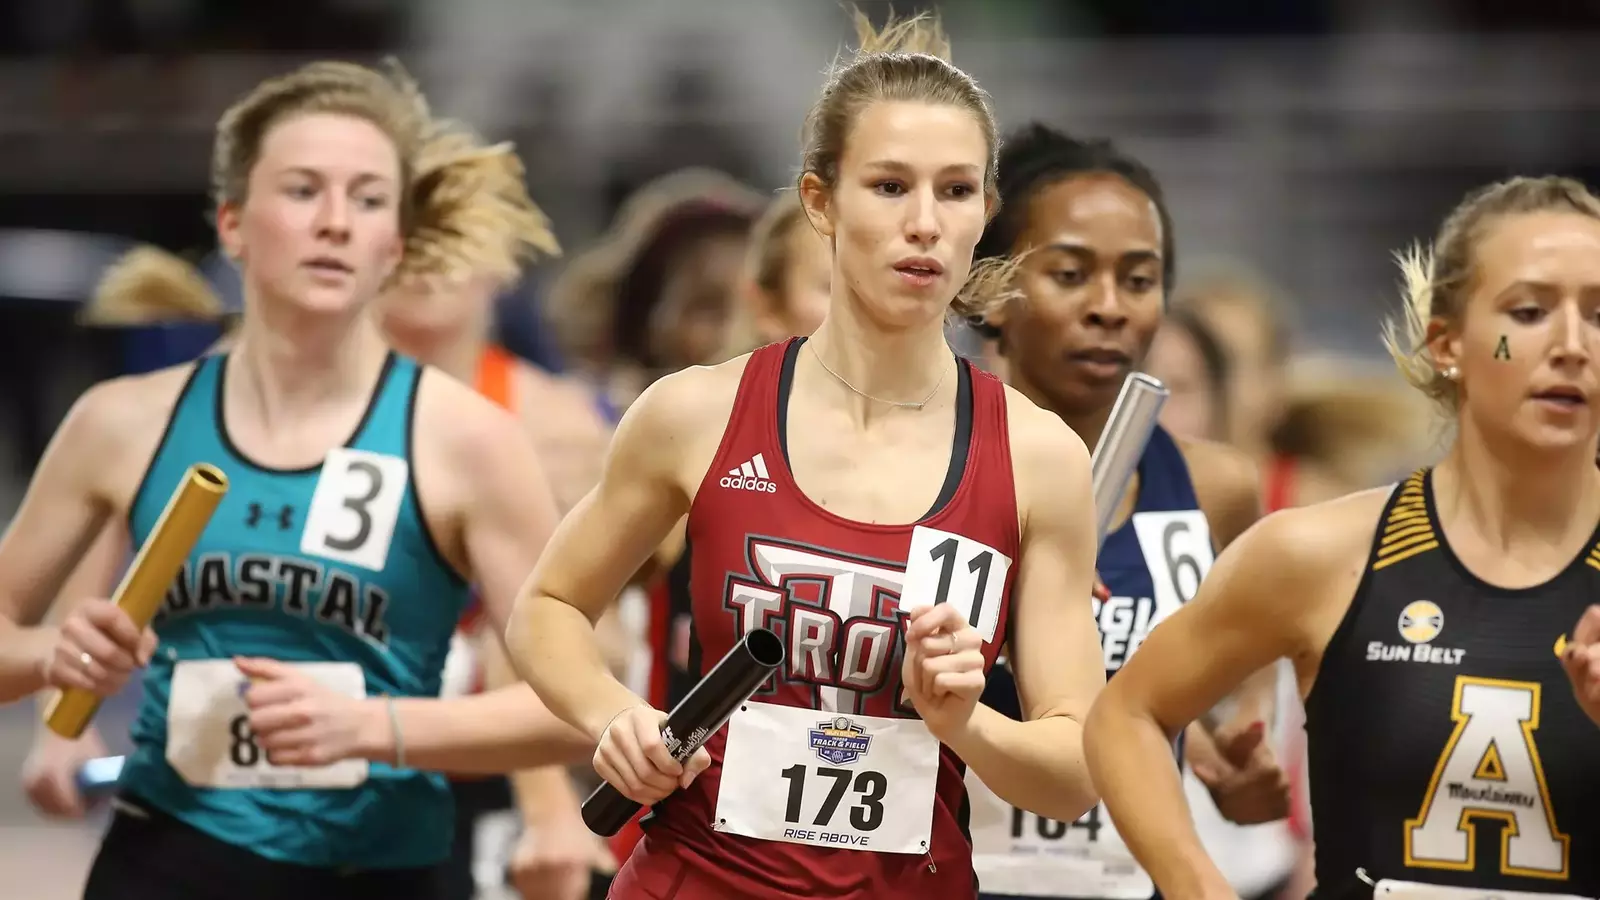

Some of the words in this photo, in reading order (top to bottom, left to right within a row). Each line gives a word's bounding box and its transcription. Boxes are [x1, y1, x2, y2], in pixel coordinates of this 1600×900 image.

[1493, 334, 1512, 360] A
[323, 460, 384, 552] 3
[719, 476, 778, 493] adidas
[929, 537, 993, 628] 11
[1162, 521, 1202, 603] 6
[724, 572, 920, 708] TRO
[1366, 641, 1411, 661] SUN
[1413, 643, 1467, 665] BELT
[813, 738, 837, 746] TRACK
[845, 742, 866, 750] FIELD
[1403, 674, 1571, 881] A
[781, 764, 888, 831] 173
[783, 828, 817, 841] RISE
[819, 832, 871, 846] ABOVE
